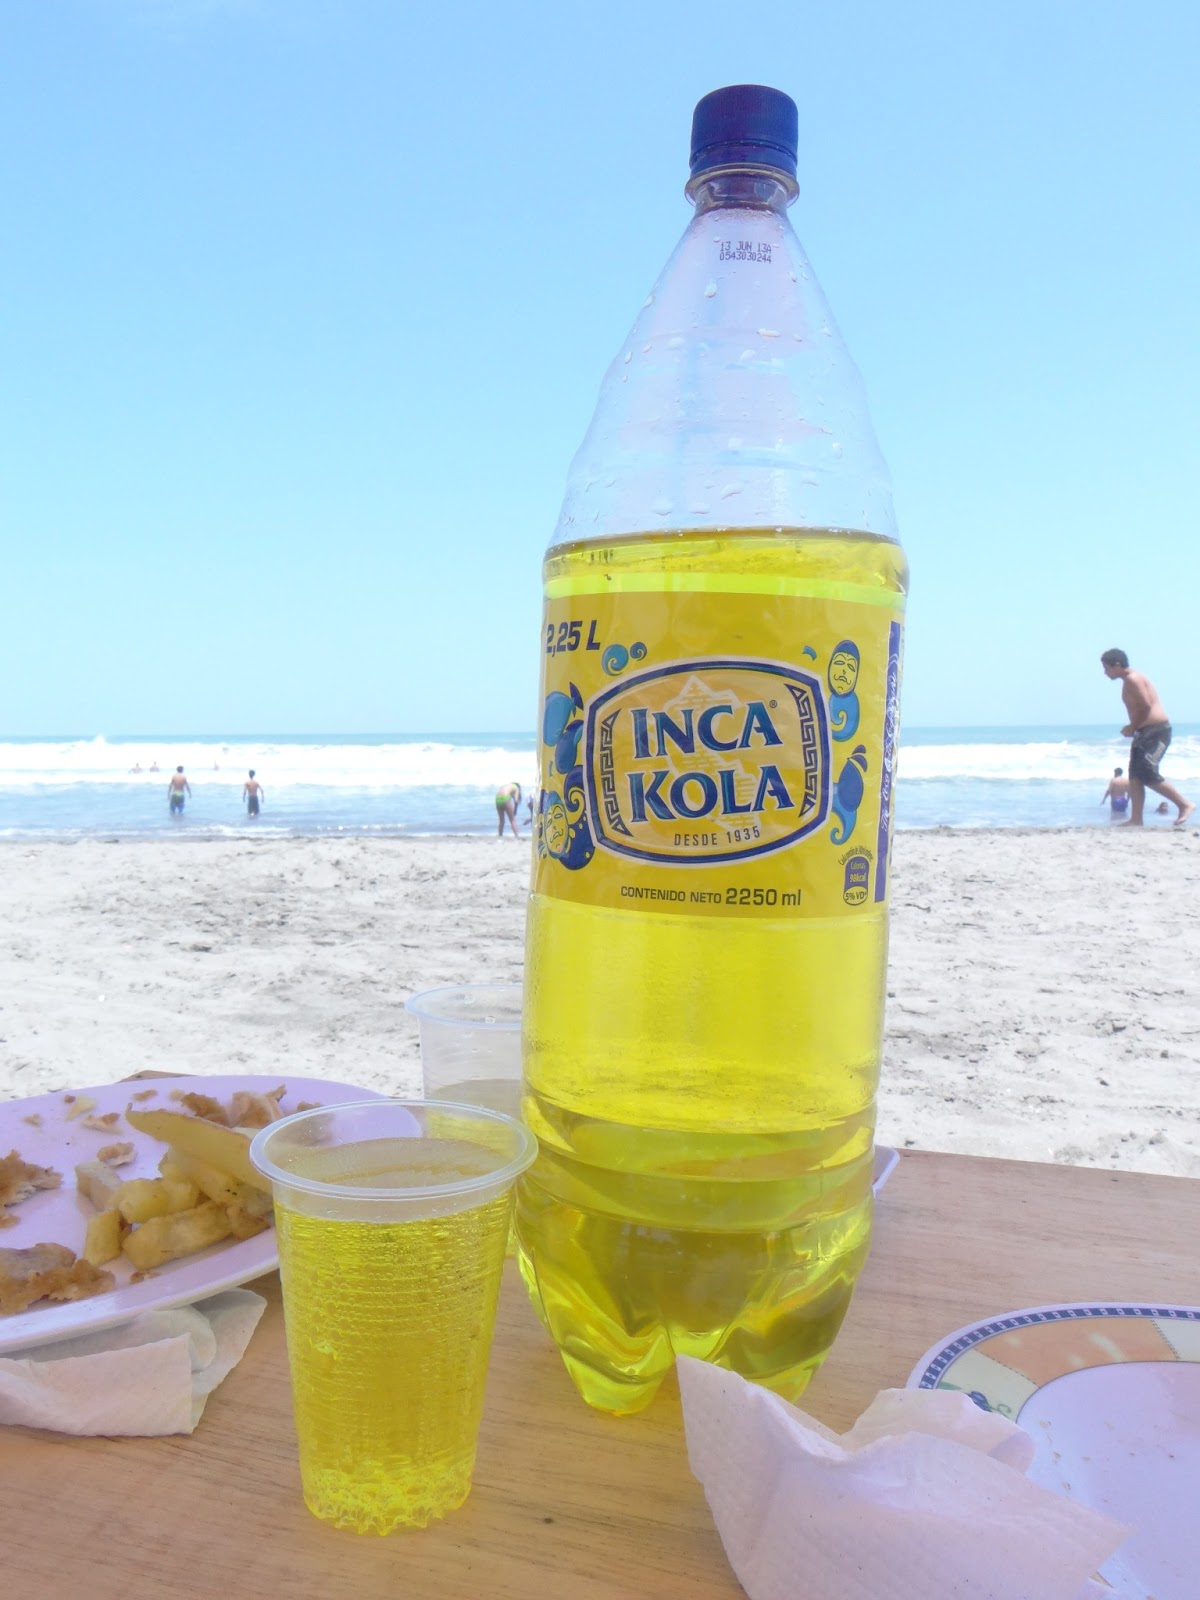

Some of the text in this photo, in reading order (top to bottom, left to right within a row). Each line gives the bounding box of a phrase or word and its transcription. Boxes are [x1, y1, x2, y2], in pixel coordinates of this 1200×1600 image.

[720, 242, 731, 251] 13
[736, 241, 752, 251] JUN
[545, 620, 600, 657] 2,25 L
[631, 702, 783, 759] INCA
[628, 766, 795, 822] KOLA
[674, 826, 760, 846] DESDE 1935
[620, 886, 802, 906] CONTENIDO NETO 2250 ml
